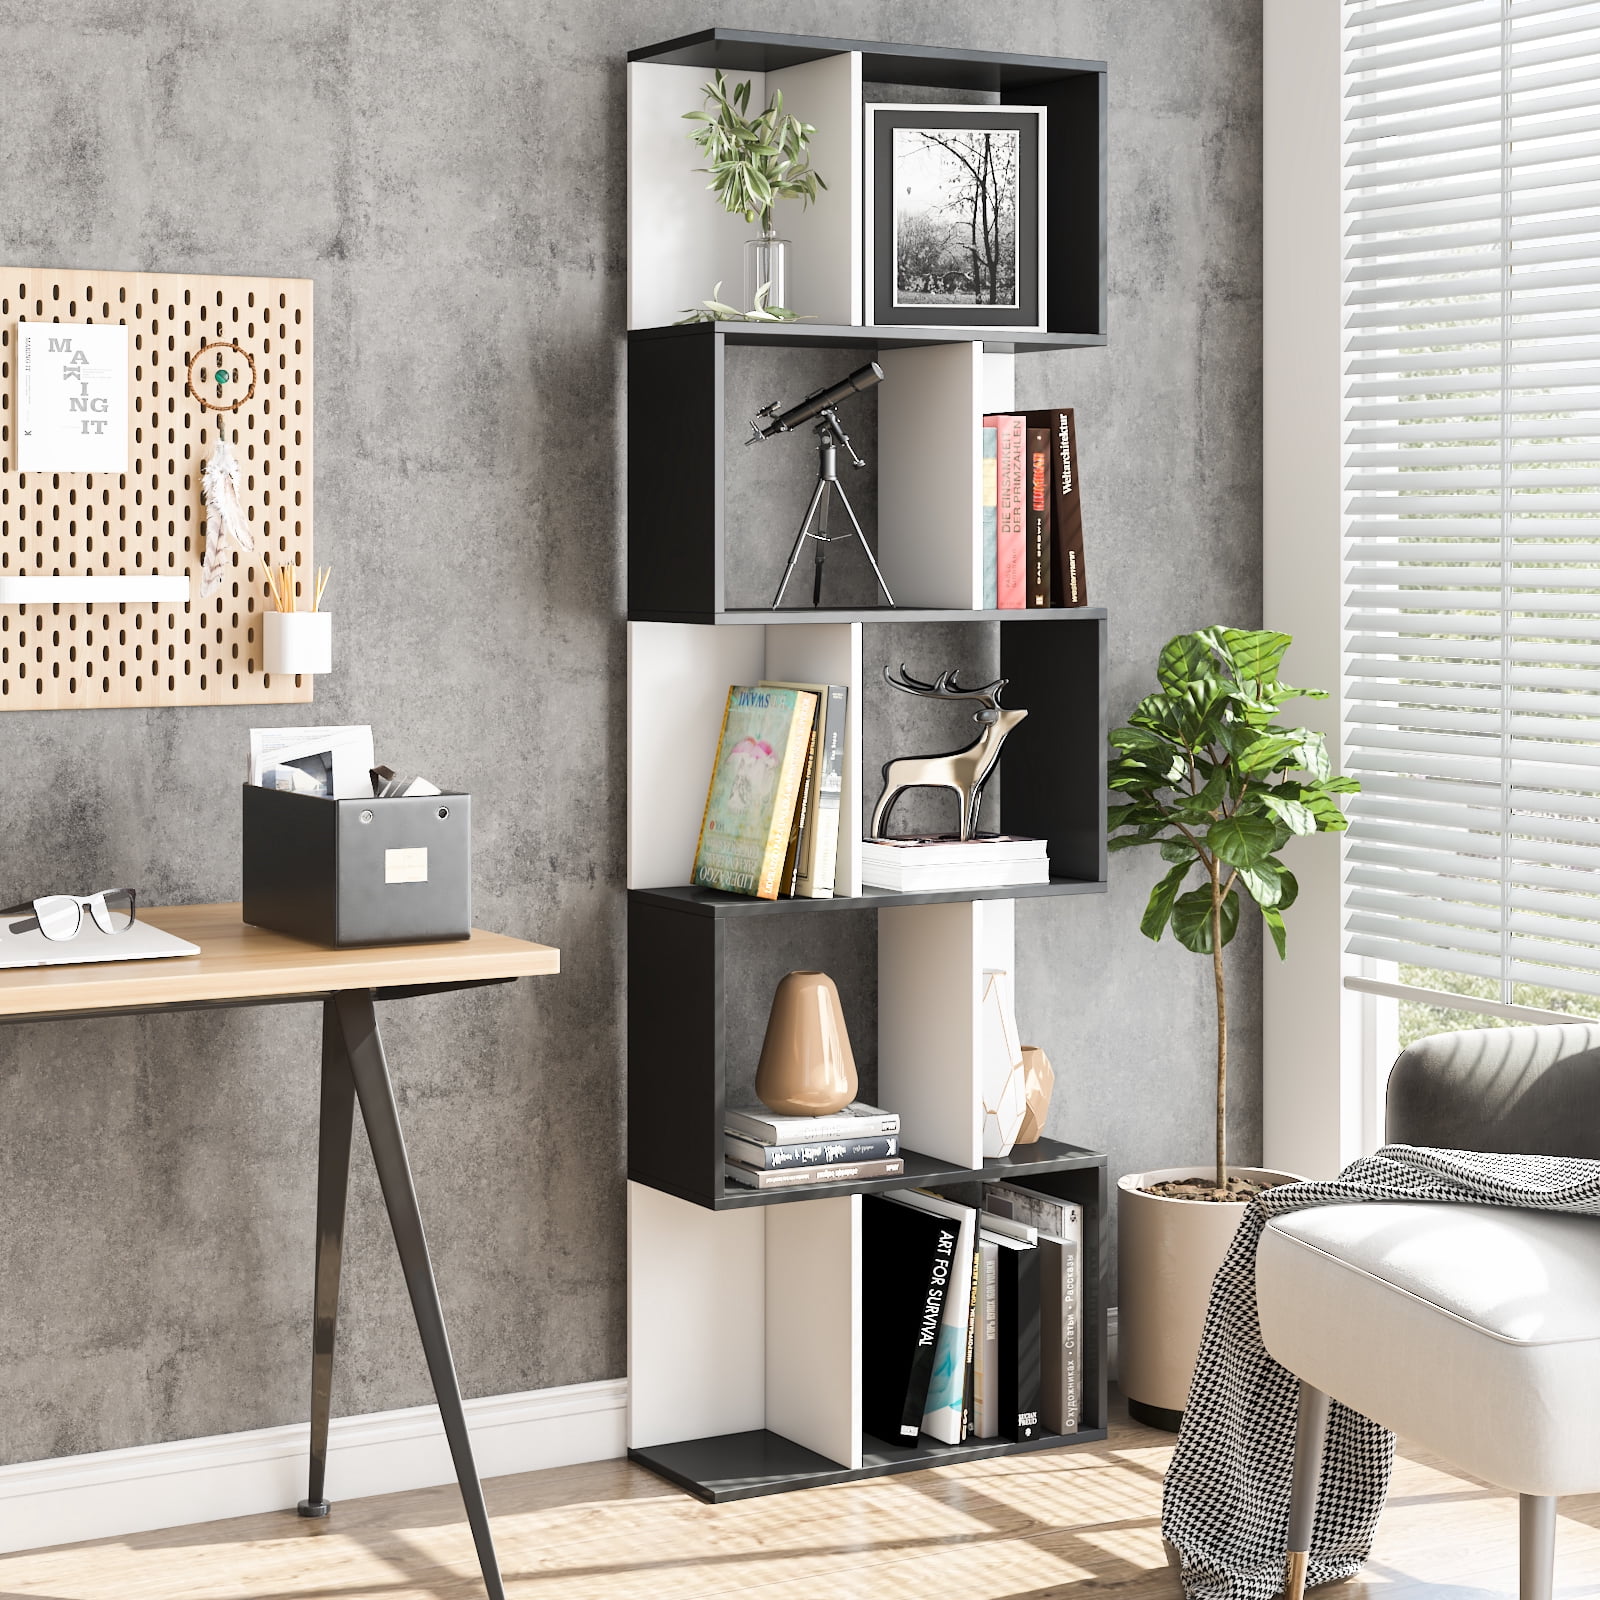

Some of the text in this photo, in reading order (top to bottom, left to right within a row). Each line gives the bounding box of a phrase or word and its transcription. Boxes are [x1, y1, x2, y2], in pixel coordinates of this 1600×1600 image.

[81, 420, 108, 435] IT
[1058, 413, 1073, 495] Weltarchitektur
[1001, 432, 1011, 533] DIE EINSAMKEIT
[1013, 420, 1022, 533] DER PRIMZAHLEN
[1068, 550, 1079, 603] westermann
[738, 692, 771, 709] SWAMI
[699, 866, 754, 890] LIDERAZGO
[918, 1230, 954, 1347] ART FOR SURVIVAL
[986, 1320, 996, 1341] ИГОРЬ
[1064, 1254, 1078, 1427] О художниках Статьи Рассказы
[1018, 1418, 1037, 1426] FREUD
